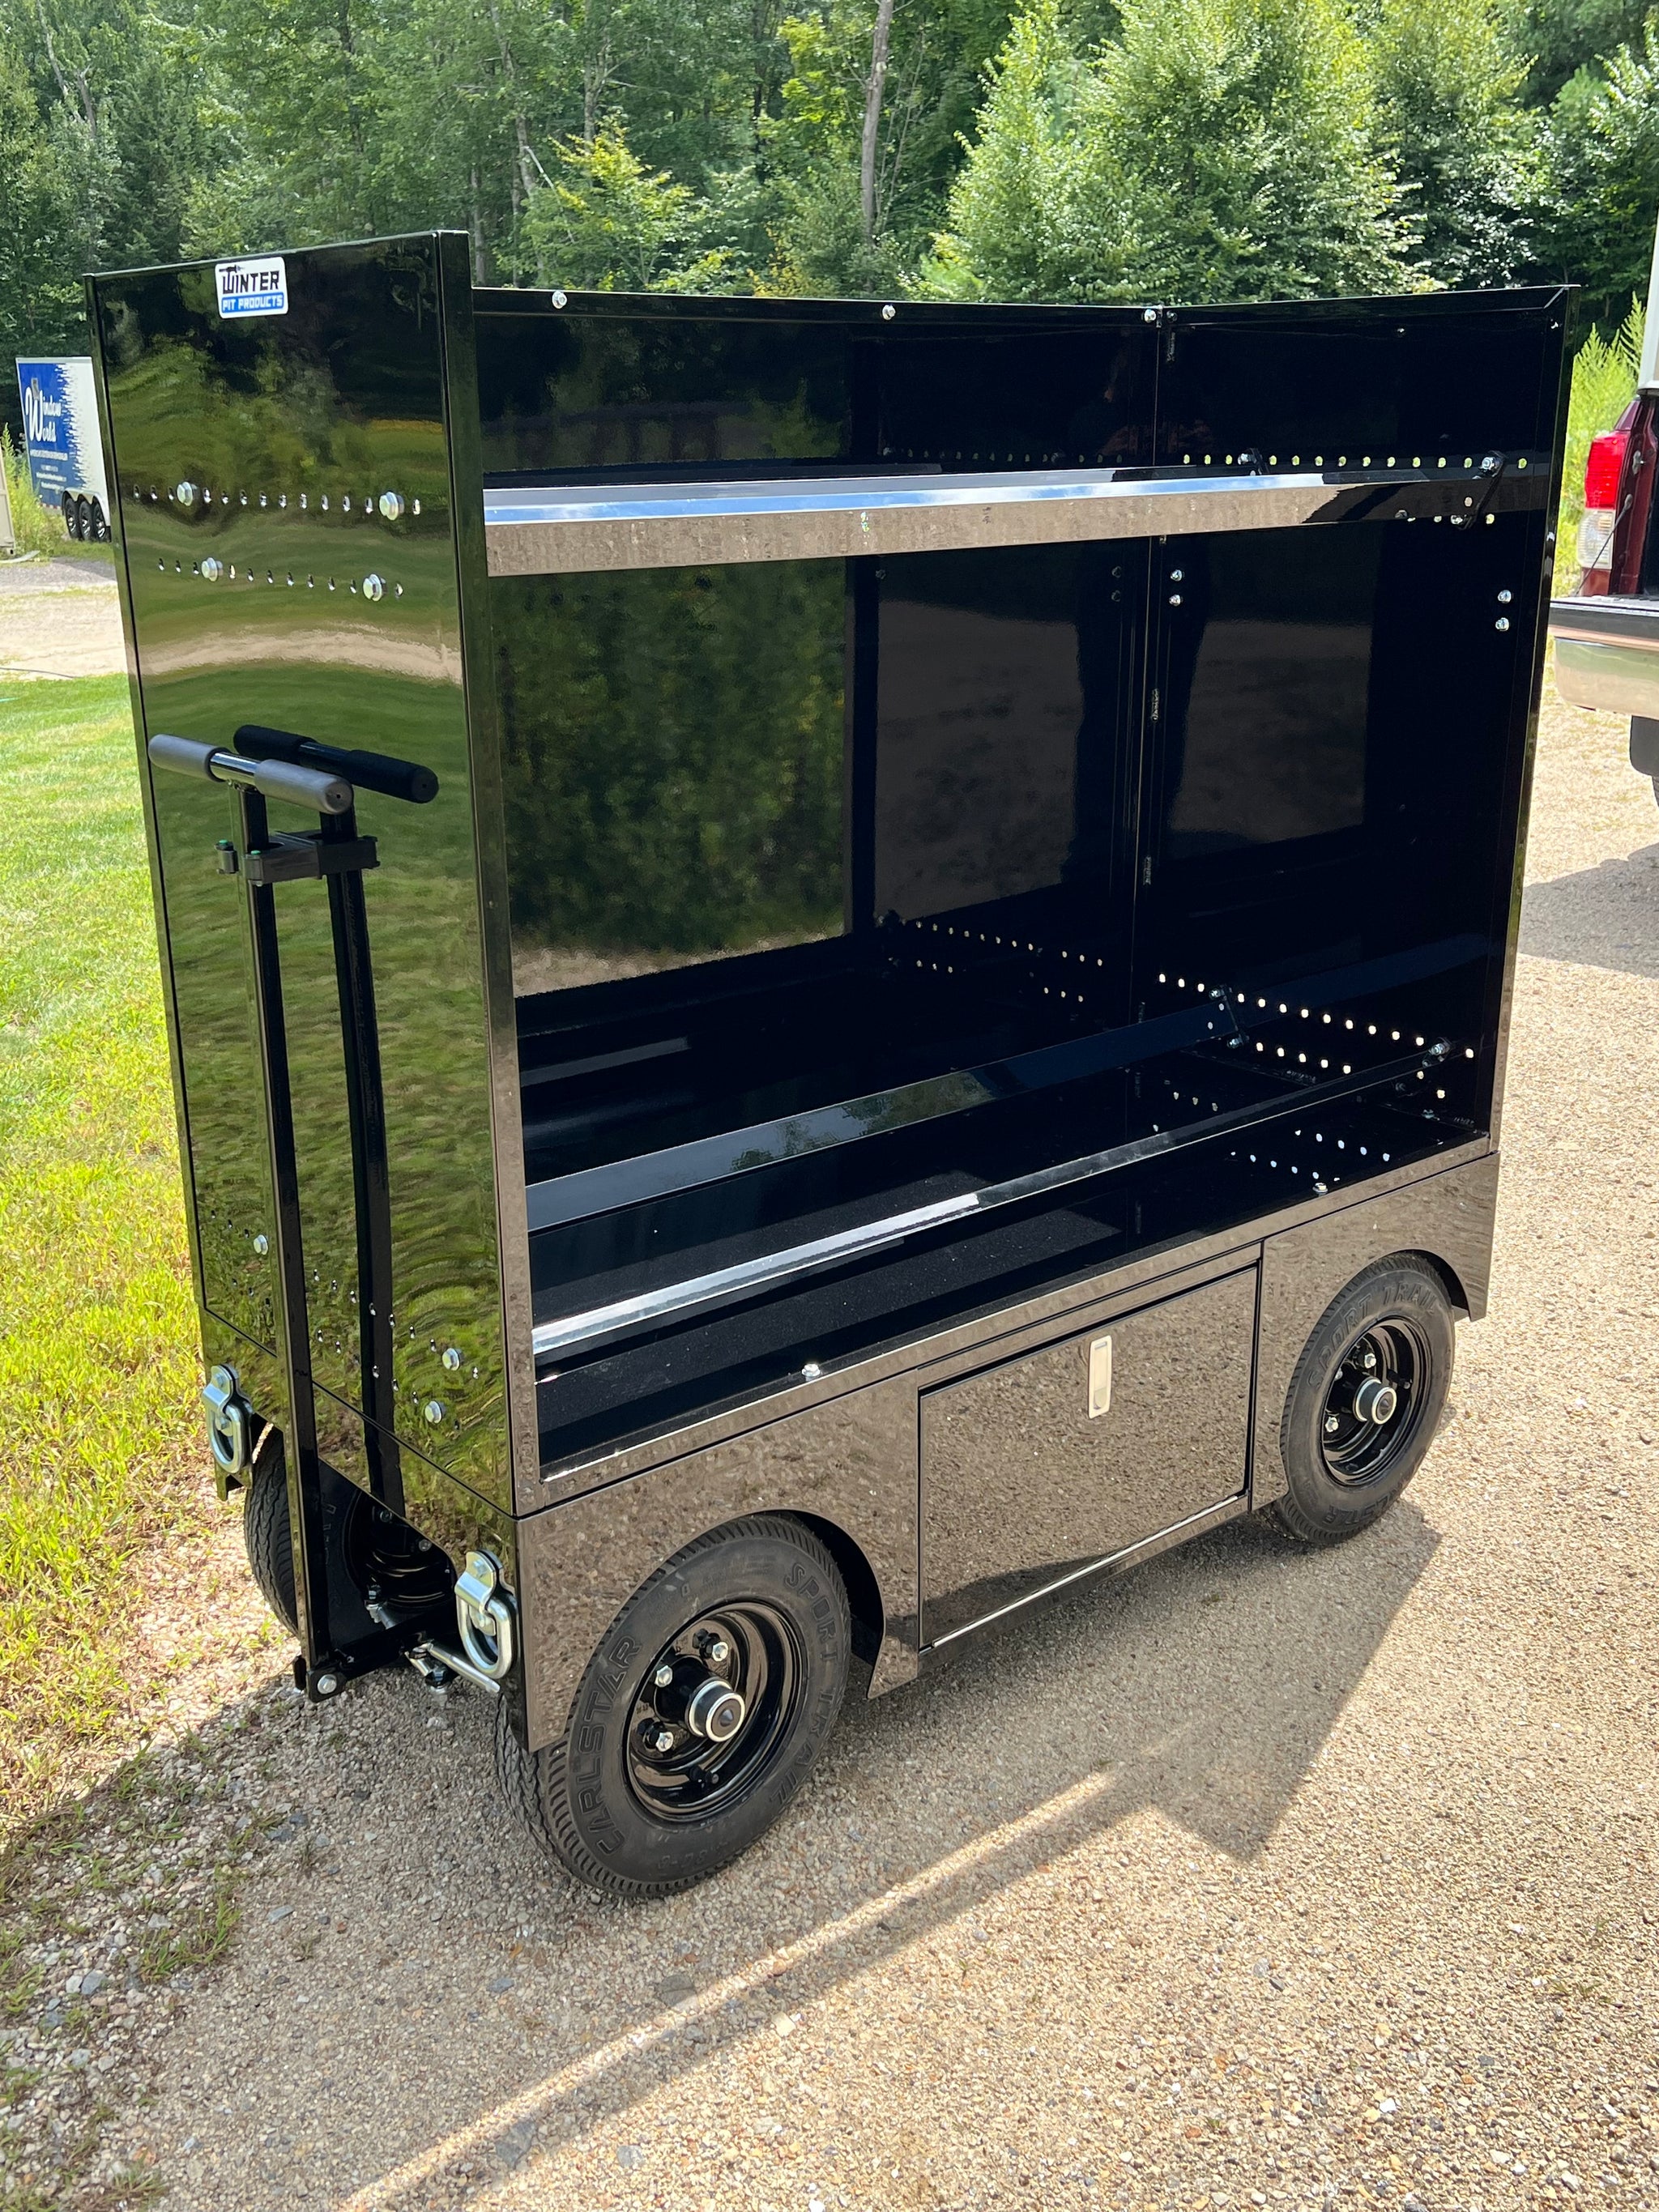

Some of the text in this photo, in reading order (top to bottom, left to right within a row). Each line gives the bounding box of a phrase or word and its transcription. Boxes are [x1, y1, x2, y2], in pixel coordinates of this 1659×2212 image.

[222, 270, 279, 294] WINTER
[222, 294, 284, 311] PIT PRODUCTS
[1307, 1281, 1439, 1391] SPORT TRAIL
[770, 1562, 840, 1805] SPORT TRAIL
[576, 1634, 642, 1855] CARLSTAR
